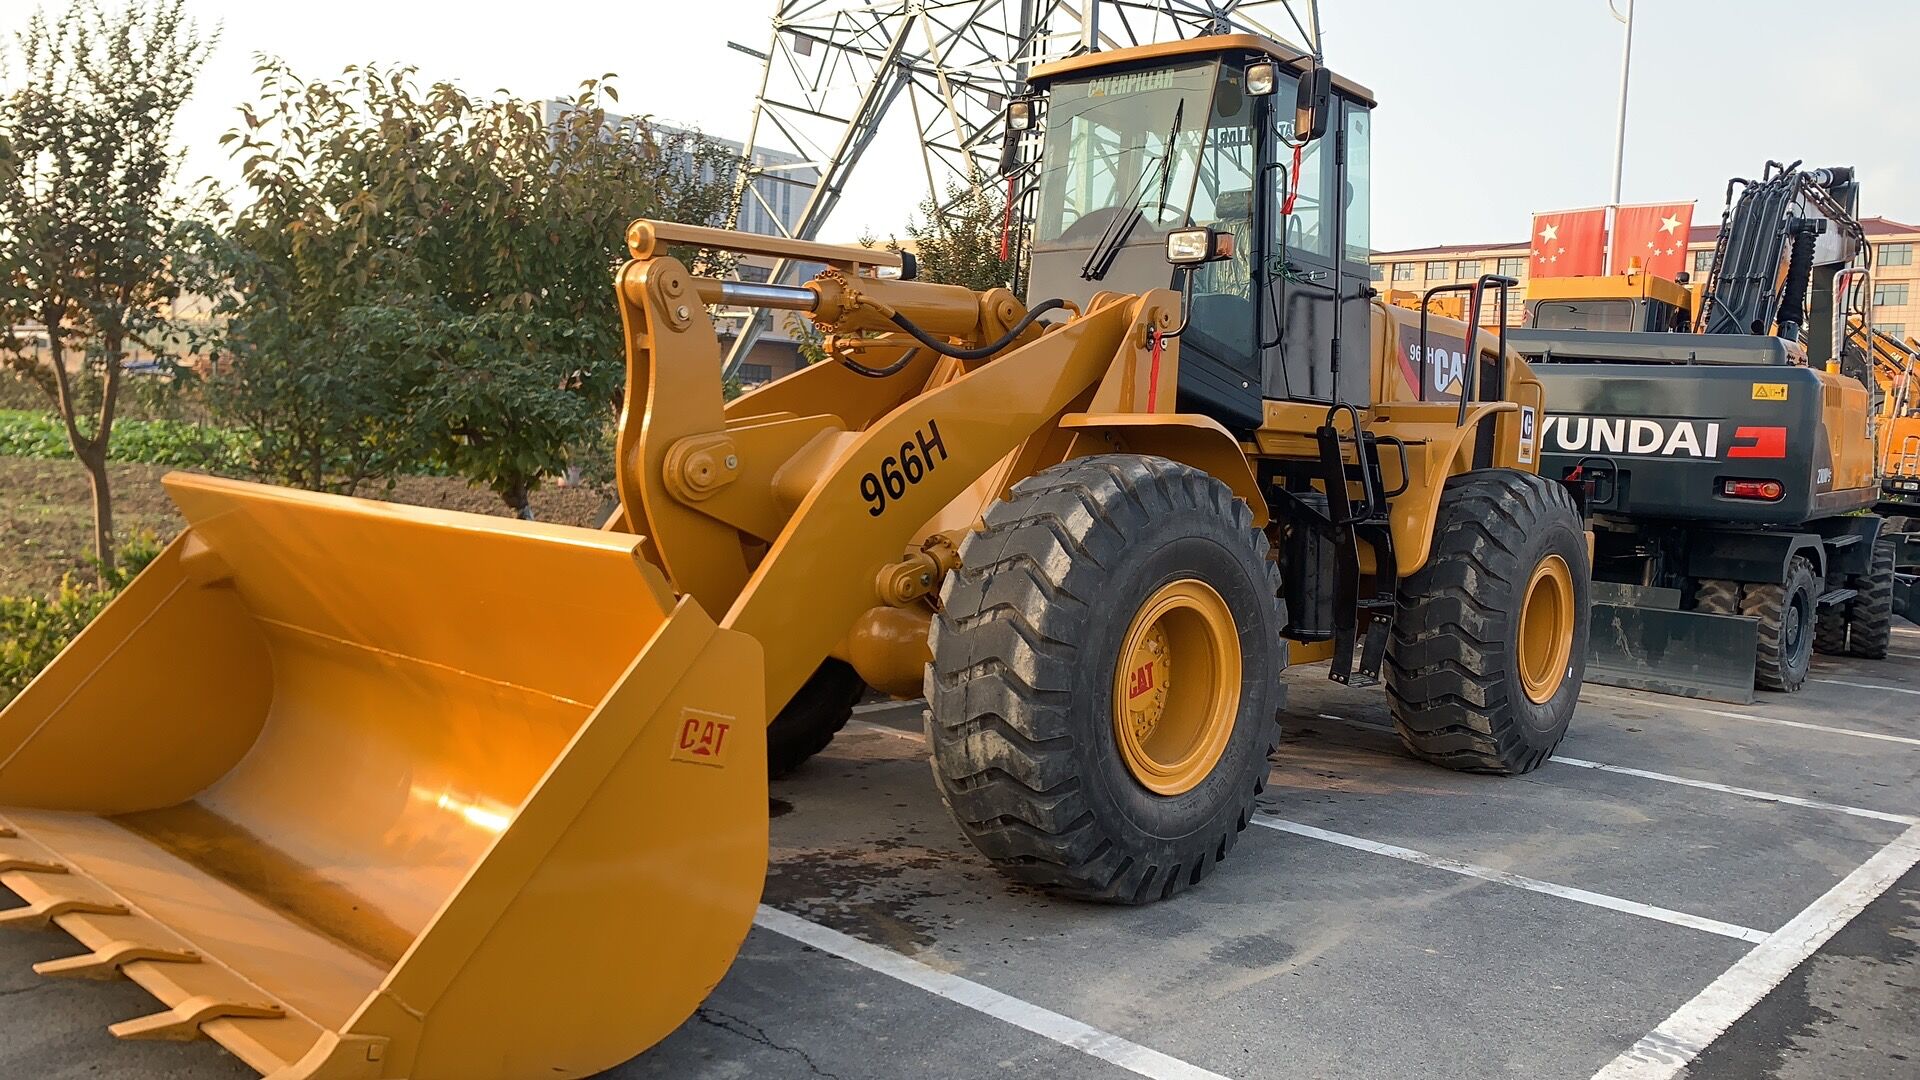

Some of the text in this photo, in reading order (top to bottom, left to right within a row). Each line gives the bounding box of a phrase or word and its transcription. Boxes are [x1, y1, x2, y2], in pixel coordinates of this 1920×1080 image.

[1088, 69, 1175, 98] CATERPILLAR
[1410, 344, 1434, 364] 96H
[1434, 348, 1467, 393] CA
[1540, 417, 1720, 458] YUNDAI
[860, 419, 948, 517] 966H
[1129, 661, 1154, 700] CAT
[680, 719, 730, 756] CAT
